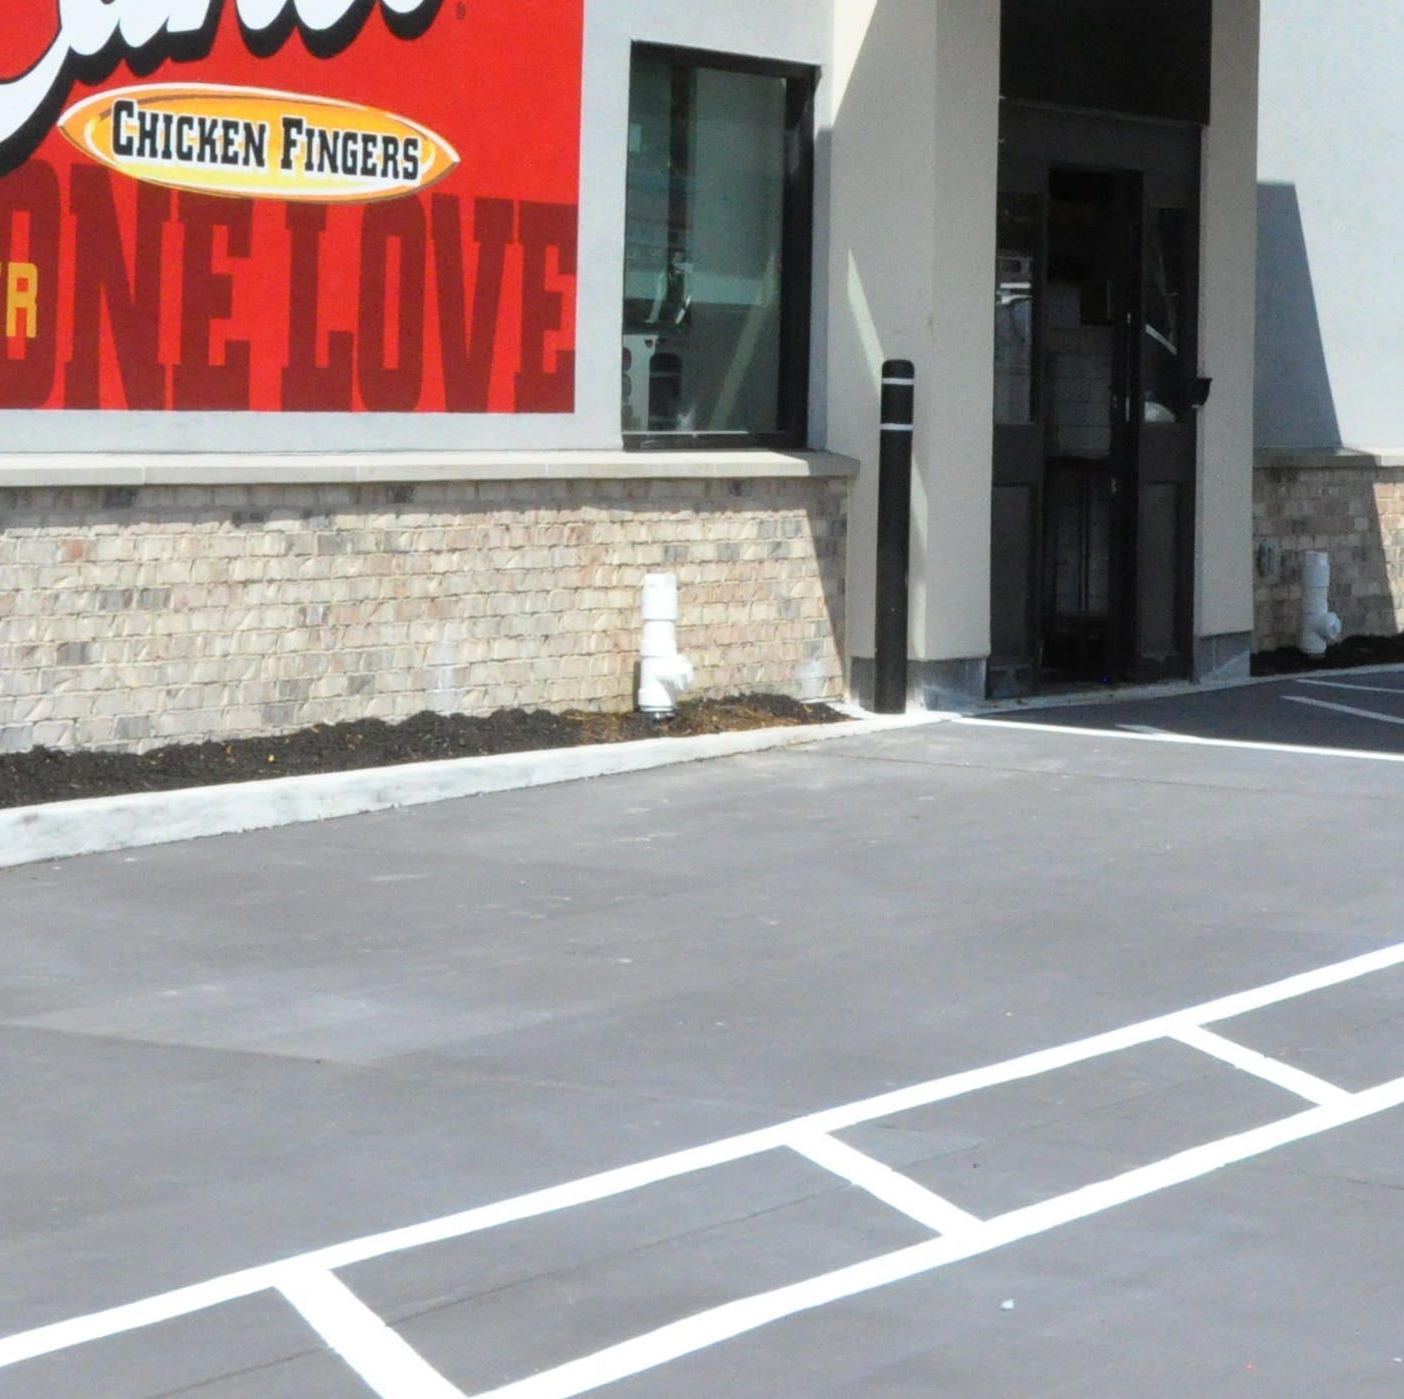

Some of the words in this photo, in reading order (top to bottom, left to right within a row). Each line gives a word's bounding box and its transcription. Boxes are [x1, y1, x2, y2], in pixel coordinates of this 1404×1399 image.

[112, 99, 266, 168] CHICKEN
[280, 116, 419, 180] FINGERS
[280, 192, 577, 413] LOVE
